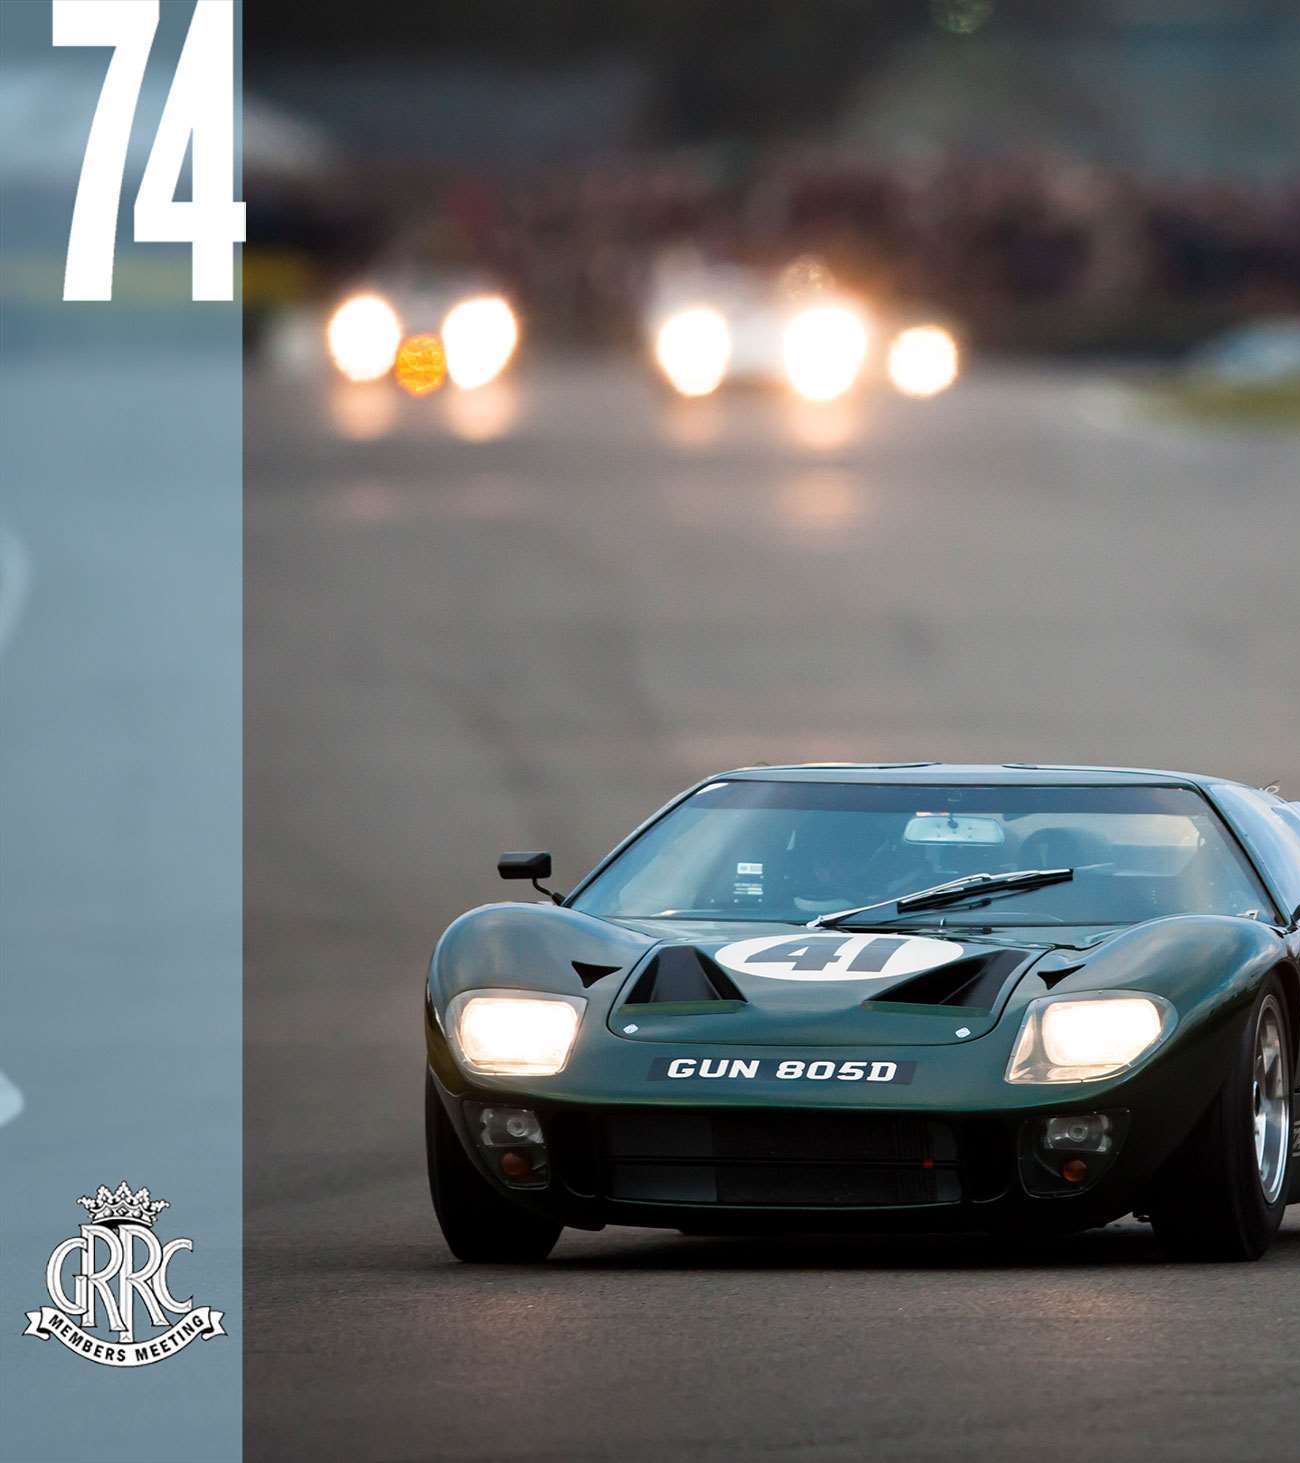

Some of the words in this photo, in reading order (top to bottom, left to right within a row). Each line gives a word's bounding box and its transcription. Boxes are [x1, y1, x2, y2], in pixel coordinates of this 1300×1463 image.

[744, 936, 912, 973] 41
[667, 1058, 761, 1079] GUN
[775, 1060, 898, 1082] 805D
